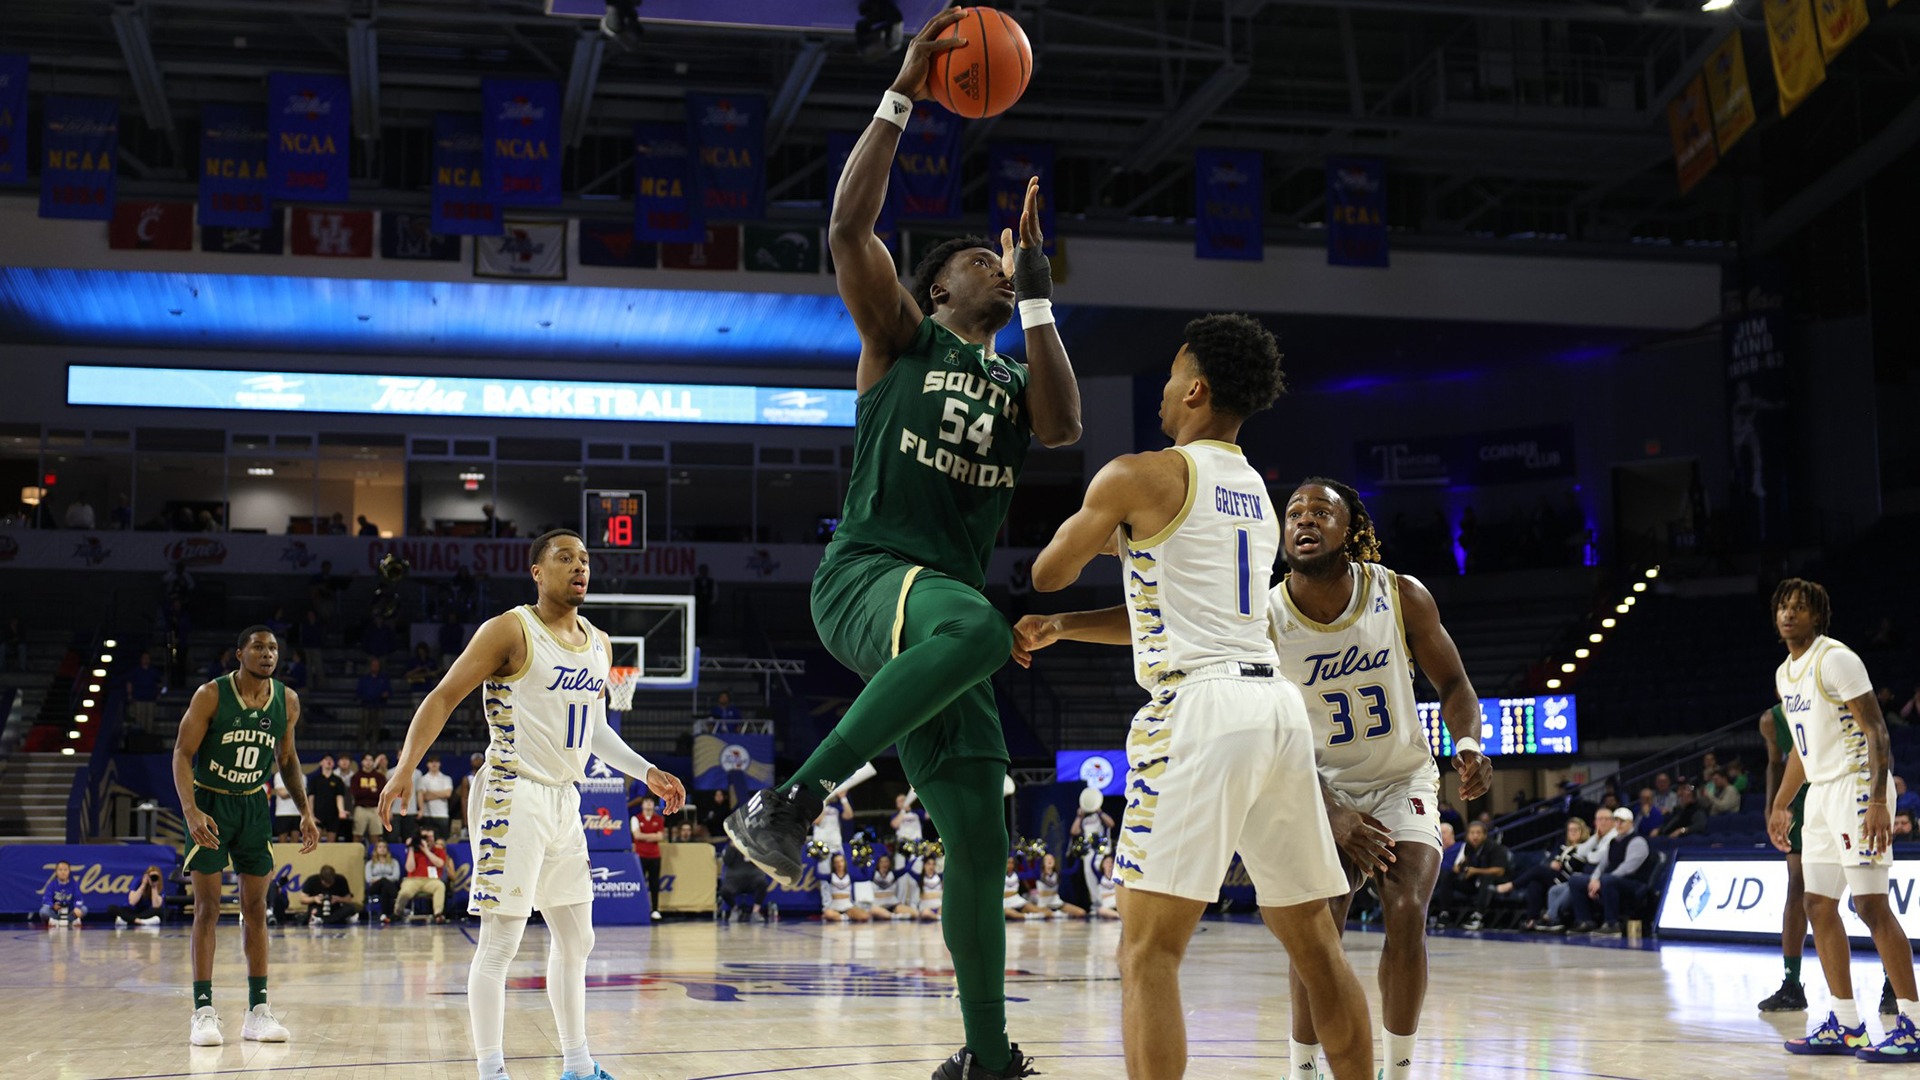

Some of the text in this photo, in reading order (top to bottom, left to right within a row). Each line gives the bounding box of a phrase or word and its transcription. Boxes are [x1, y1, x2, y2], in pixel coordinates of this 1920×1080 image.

[970, 63, 980, 100] adidas
[280, 131, 337, 156] NCAA
[495, 137, 549, 161] NCAA
[49, 151, 111, 171] NCAA
[205, 157, 268, 179] NCAA
[700, 147, 752, 169] NCAA
[900, 154, 949, 176] NCAA
[436, 166, 483, 188] NCA
[640, 176, 684, 198] NCA
[1739, 316, 1767, 338] JIM
[1732, 333, 1773, 360] KING
[371, 377, 701, 418] Tulsa BASKETBALL
[923, 370, 1019, 425] SOUTH
[939, 397, 994, 457] 54
[900, 427, 1014, 488] FLORIDA
[1479, 441, 1538, 461] CORNER
[1525, 450, 1560, 468] CLUB
[1215, 485, 1263, 521] GRIFFIN
[608, 515, 632, 546] 18
[474, 543, 531, 573] STUD
[594, 542, 695, 575] SCTION
[1236, 527, 1252, 616] 1
[546, 665, 604, 692] Tulsa
[1303, 645, 1390, 686] Tulsa
[1320, 684, 1393, 746] 33
[1784, 694, 1811, 713] Tulsa
[221, 729, 276, 749] SOUTH
[565, 703, 588, 749] 11
[1796, 723, 1808, 756] 0
[235, 745, 259, 769] 10
[583, 814, 623, 830] Tulsa
[36, 863, 134, 895] Tlsa
[592, 881, 641, 892] HORNTON
[1716, 877, 1764, 910] JD
